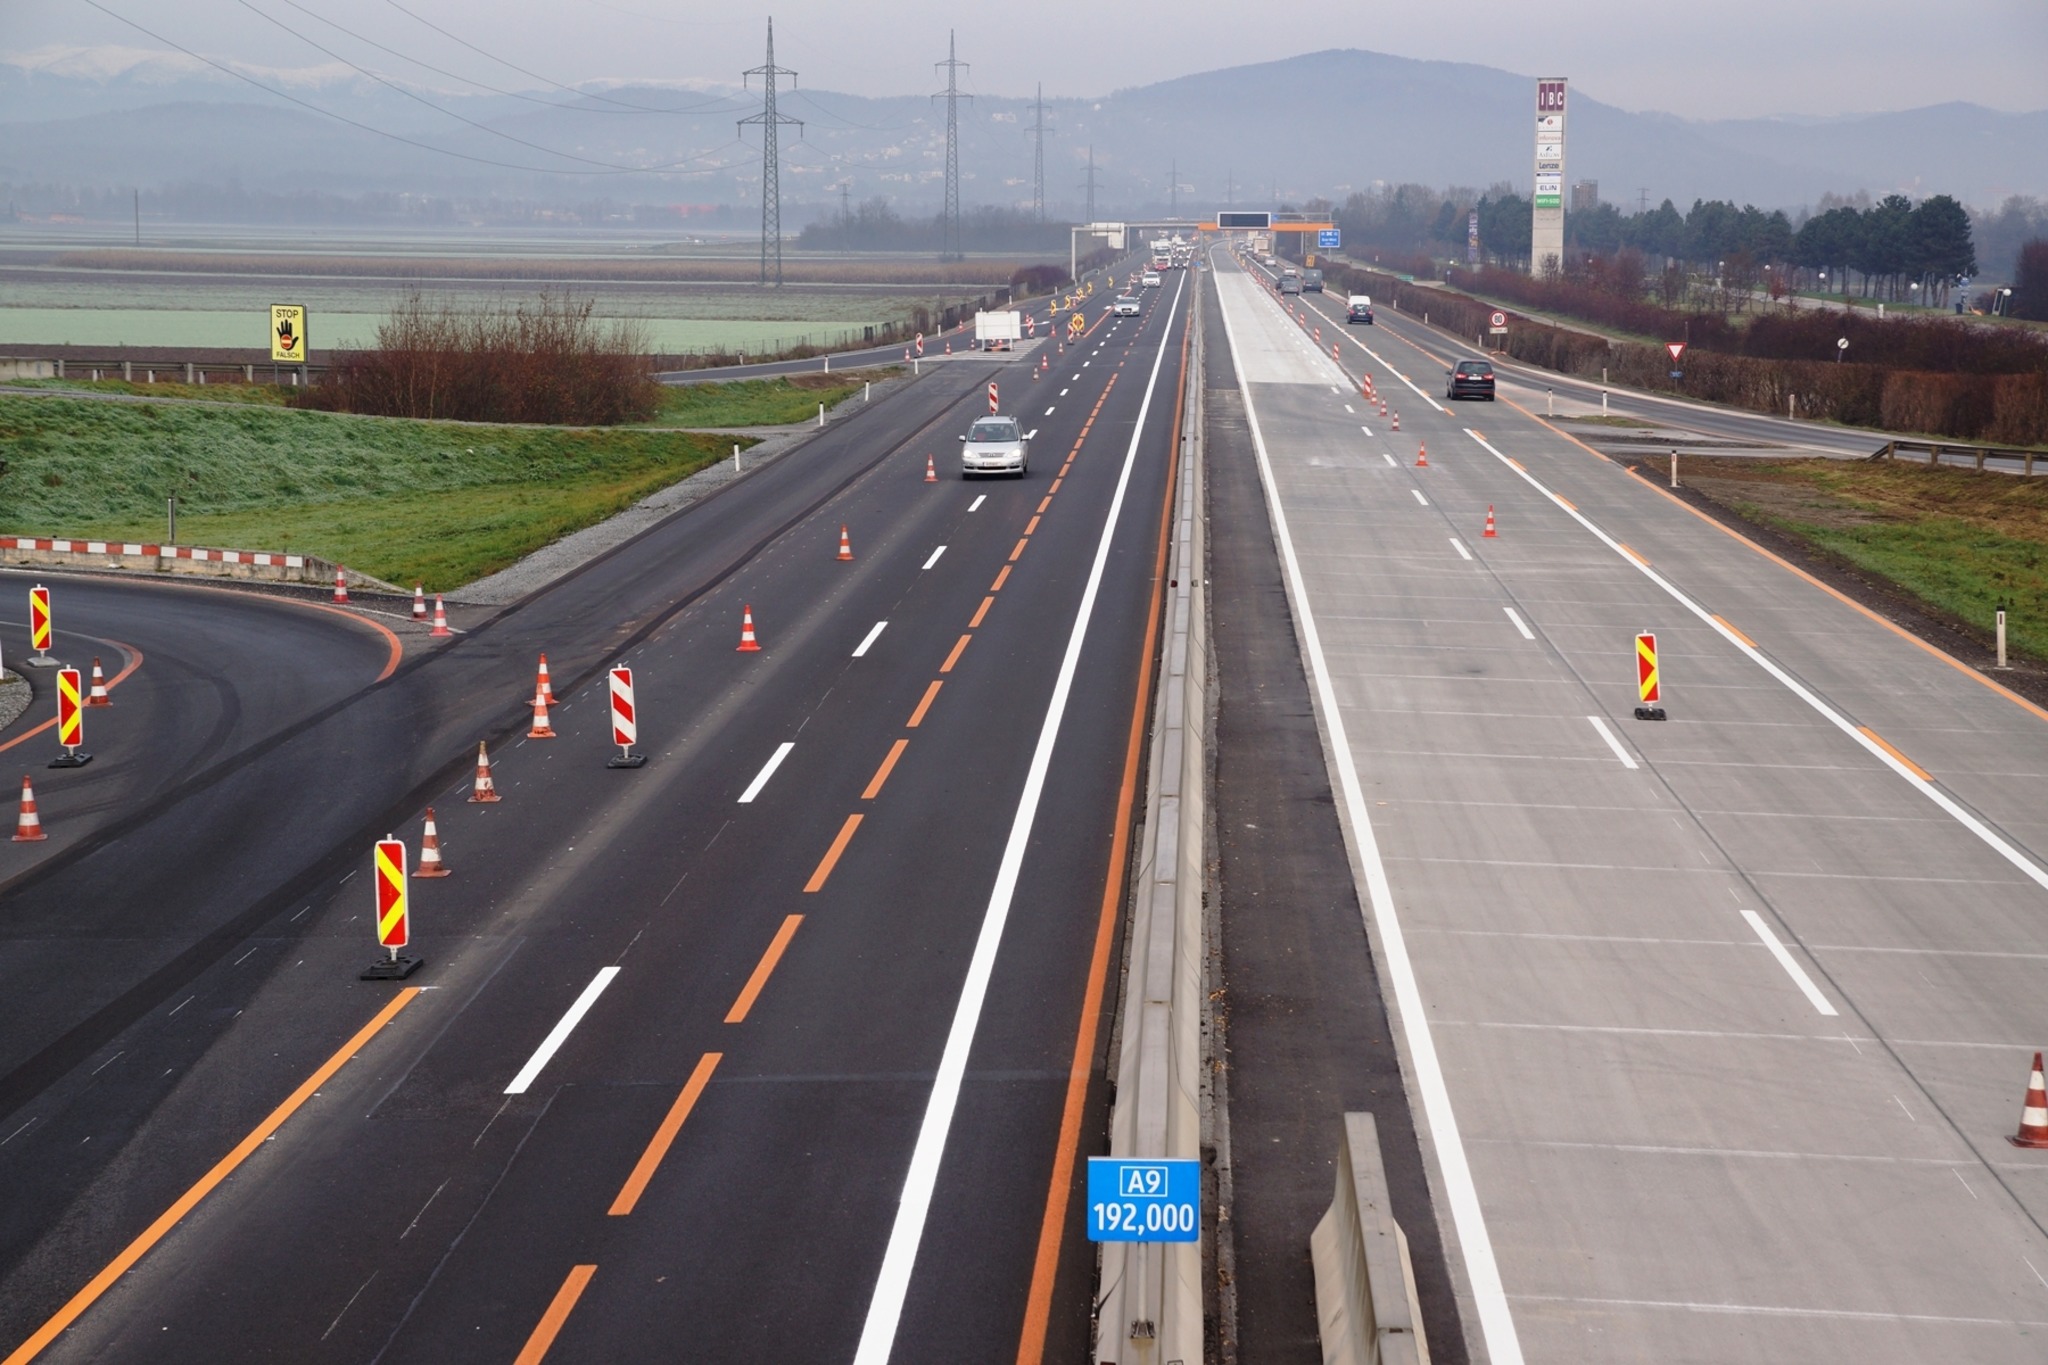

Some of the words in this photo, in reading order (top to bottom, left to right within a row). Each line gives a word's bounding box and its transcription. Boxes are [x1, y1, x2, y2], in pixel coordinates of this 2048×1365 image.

[1541, 92, 1563, 106] IBC
[276, 309, 299, 319] STOP
[276, 351, 300, 359] FALSCH
[1127, 1170, 1161, 1194] A9
[1093, 1202, 1195, 1237] 192,000
